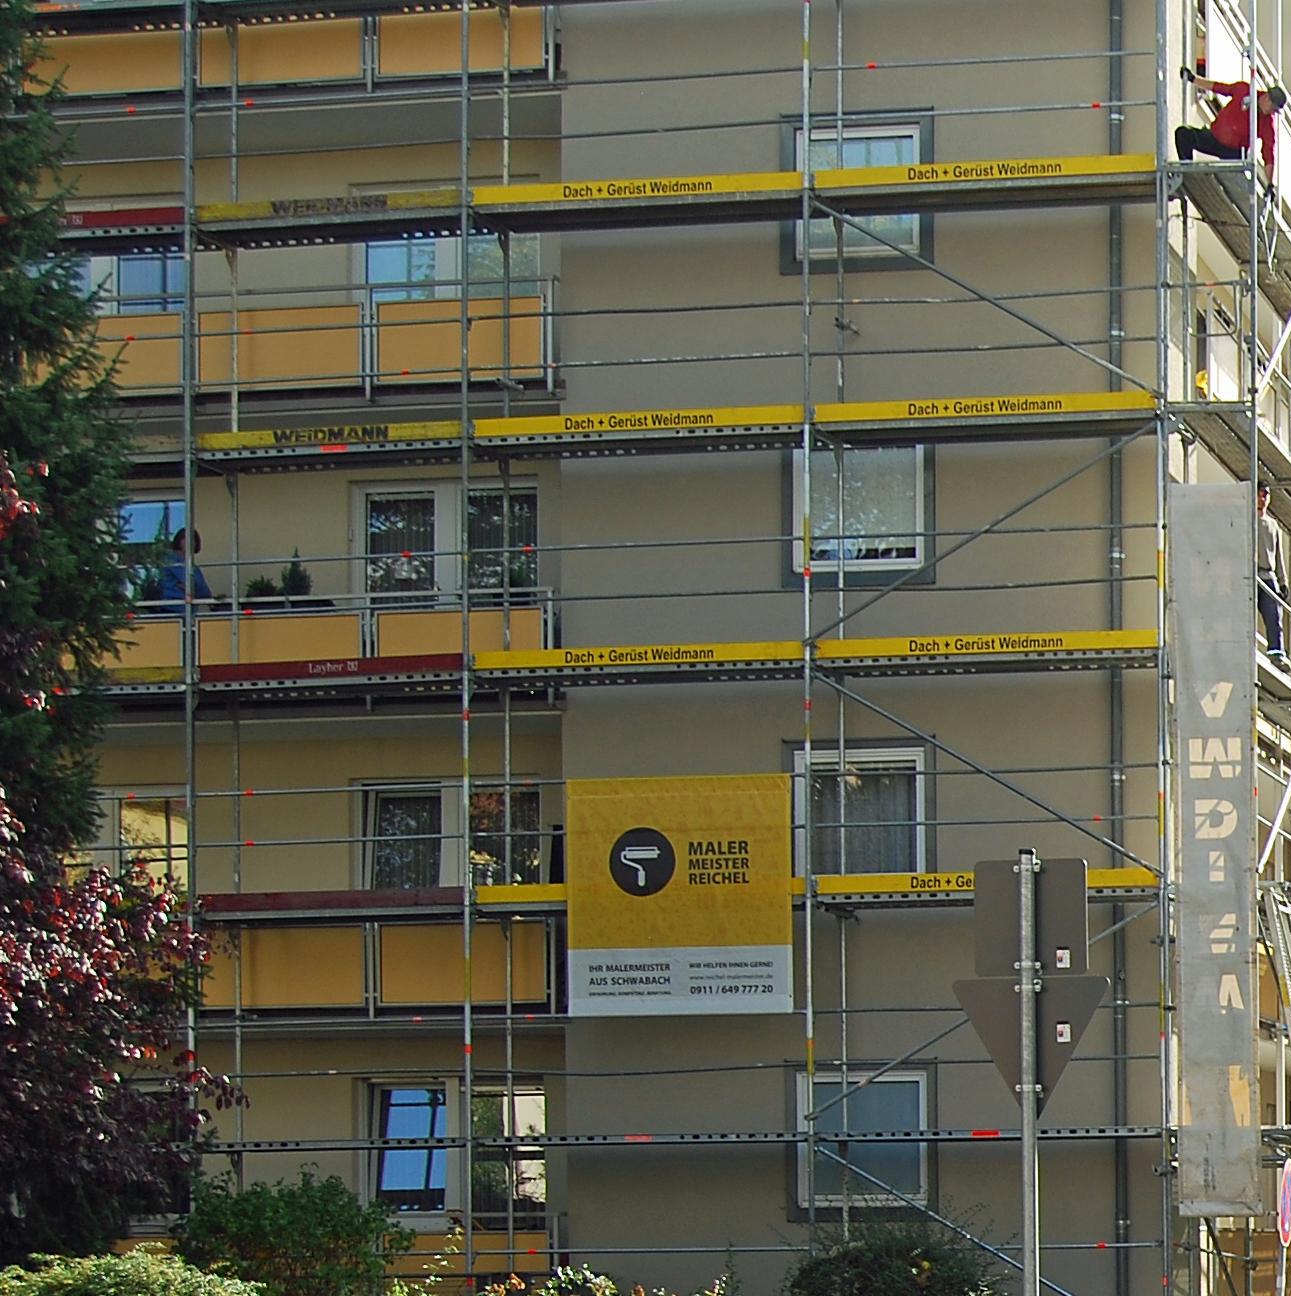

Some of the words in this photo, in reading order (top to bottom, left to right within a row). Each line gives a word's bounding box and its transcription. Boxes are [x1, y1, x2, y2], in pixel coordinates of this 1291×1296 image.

[907, 167, 938, 180] Dach
[953, 164, 994, 177] Gerüst
[997, 162, 1062, 176] Weidmann
[563, 185, 593, 198] Dach
[607, 182, 647, 195] Gerüst
[650, 181, 712, 194] Weidmann
[908, 402, 939, 416] Dach
[953, 401, 994, 414] Gerüst
[997, 399, 1062, 413] Weidmann
[564, 417, 594, 430] Dach
[608, 415, 648, 428] Gerüst
[651, 413, 713, 426] Weidmann
[909, 639, 940, 652] Dach
[954, 637, 995, 651] Gerüst
[998, 636, 1063, 649] Weidmann
[564, 650, 594, 664] Dach
[608, 649, 648, 662] Gerüst
[651, 647, 714, 660] Weidmann
[309, 661, 344, 675] Layher
[688, 840, 749, 856] MALER
[688, 857, 750, 870] MEISTER
[688, 871, 750, 885] REICHEL
[911, 876, 940, 889] Dach
[588, 964, 603, 973] IHR
[606, 962, 671, 973] MALERMEISTER
[589, 976, 608, 986] AUS
[611, 975, 671, 986] SCHWABACH
[689, 985, 714, 995] 0911
[721, 984, 740, 995] 649
[742, 984, 760, 994] 777
[760, 984, 774, 994] 20
